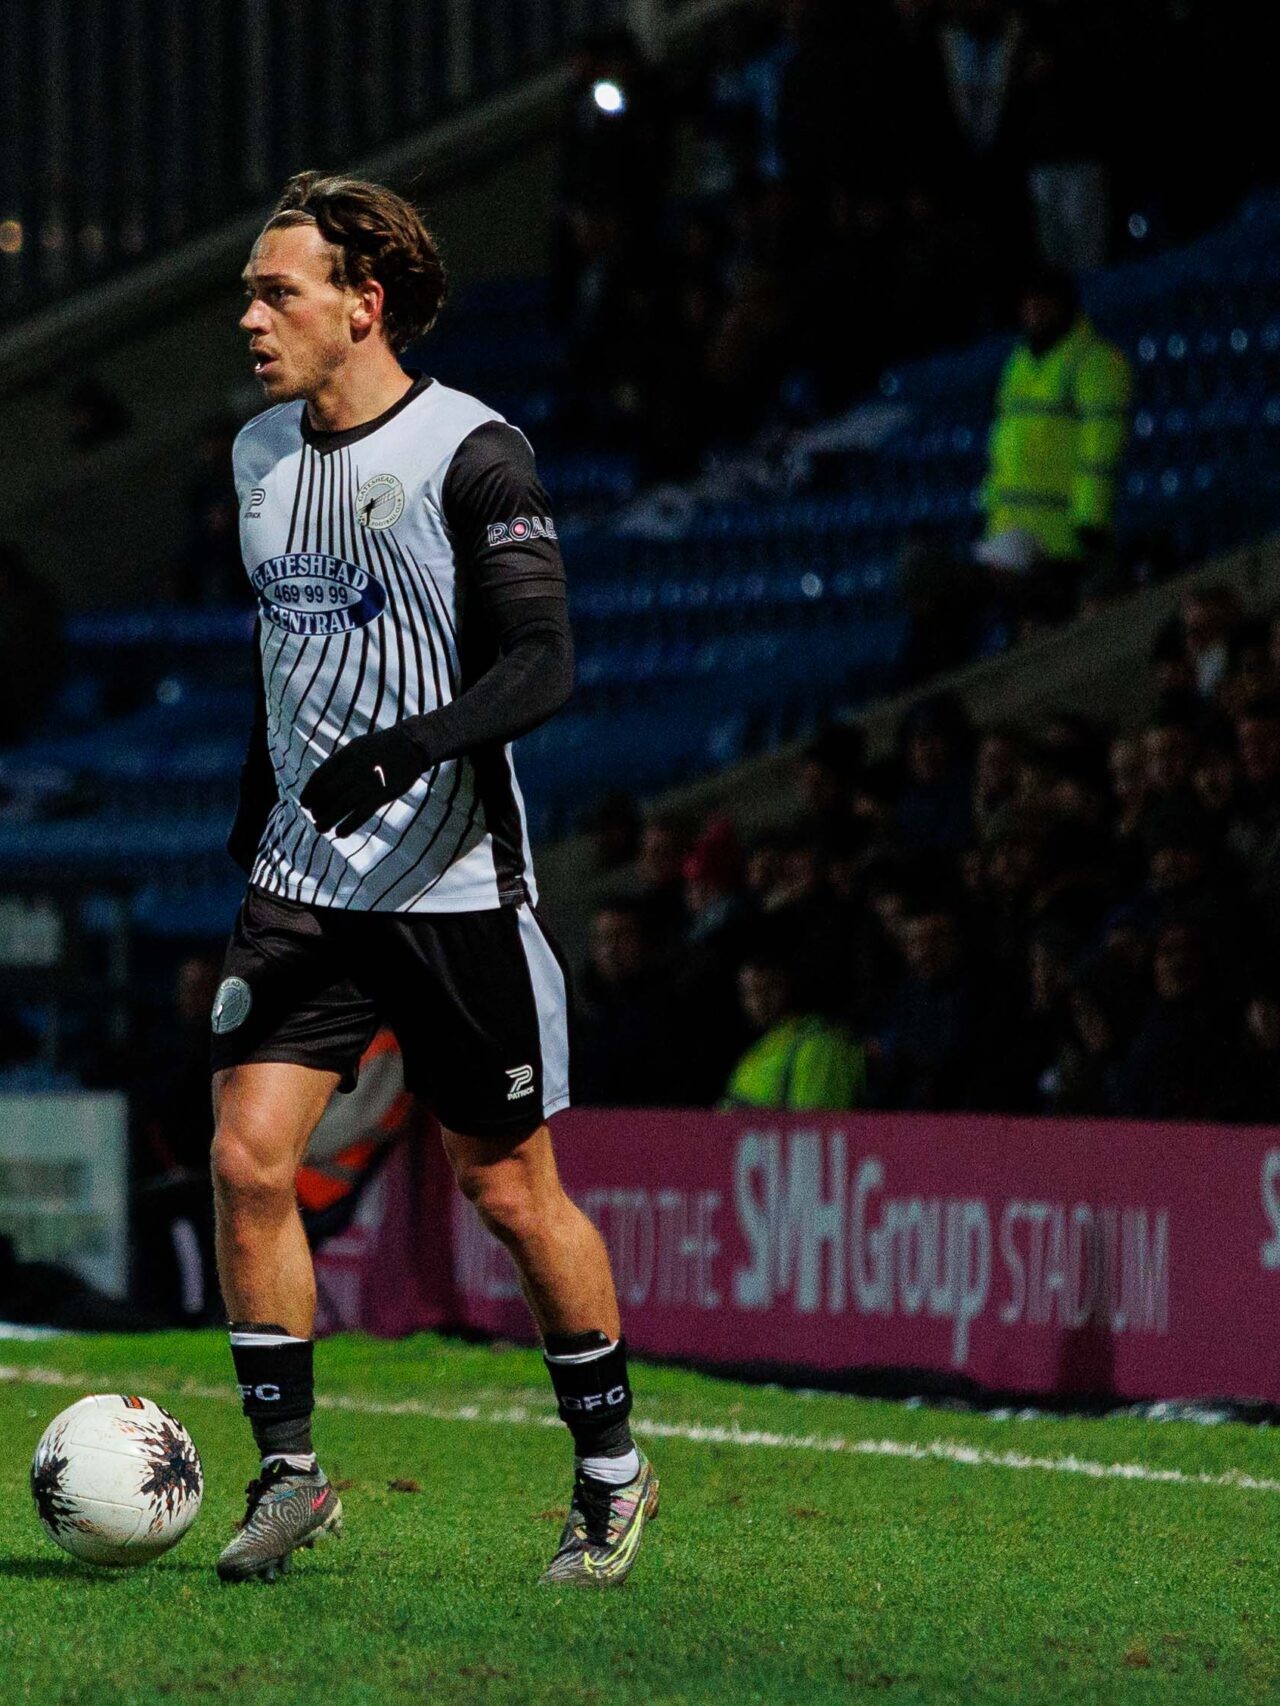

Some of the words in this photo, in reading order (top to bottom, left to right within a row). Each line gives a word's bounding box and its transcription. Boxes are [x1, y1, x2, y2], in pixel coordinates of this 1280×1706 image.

[252, 555, 369, 591] GATESHEAD
[274, 585, 300, 604] 469
[305, 585, 324, 604] 99
[328, 586, 348, 604] 99
[269, 604, 356, 634] CENTRAL
[560, 1384, 627, 1412] GFC
